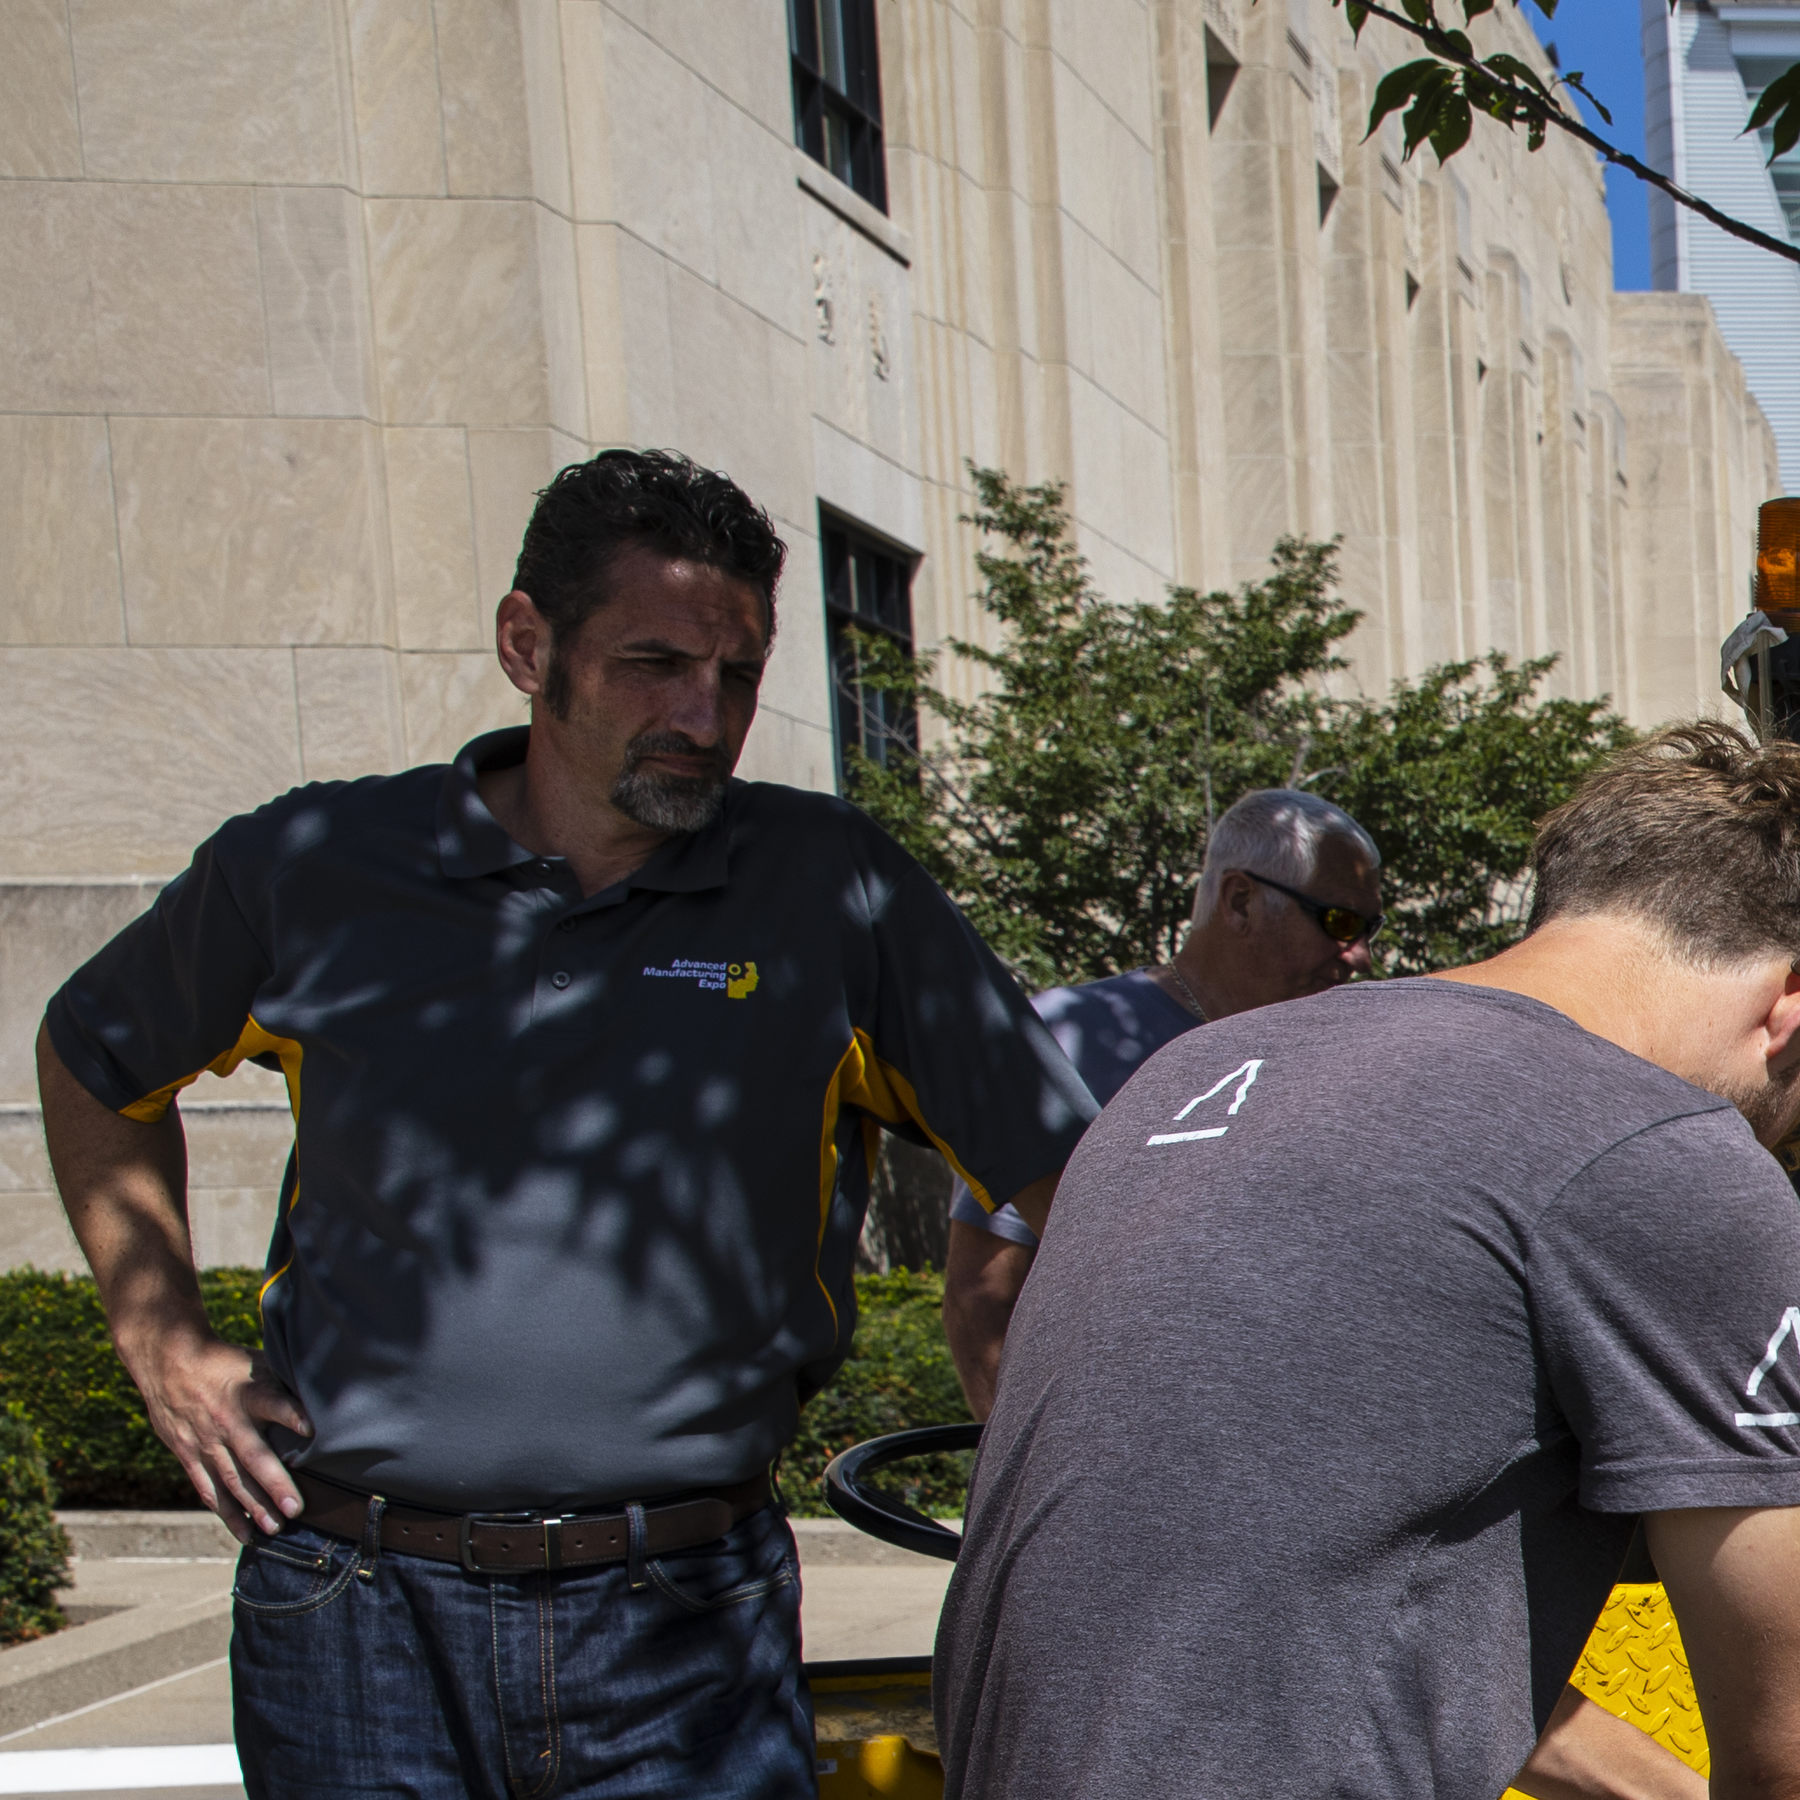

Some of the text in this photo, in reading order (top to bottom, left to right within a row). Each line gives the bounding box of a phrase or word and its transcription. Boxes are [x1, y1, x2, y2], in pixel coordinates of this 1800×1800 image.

[672, 958, 728, 971] Advanced
[642, 966, 728, 982] Manufacturing
[697, 978, 728, 991] Expo
